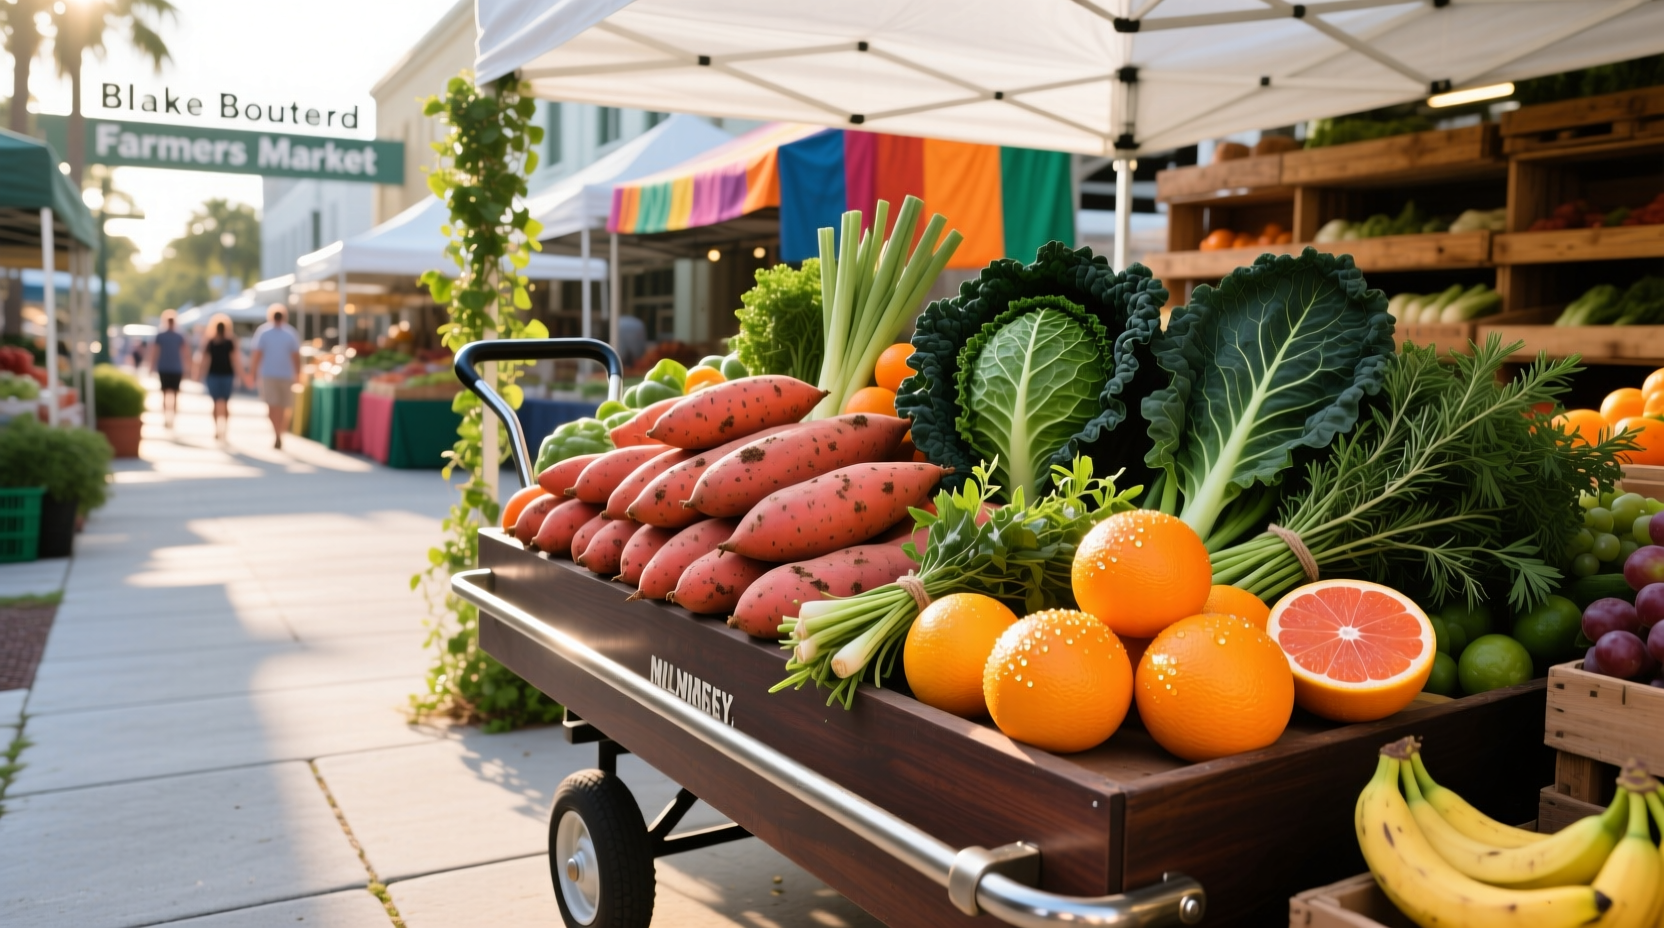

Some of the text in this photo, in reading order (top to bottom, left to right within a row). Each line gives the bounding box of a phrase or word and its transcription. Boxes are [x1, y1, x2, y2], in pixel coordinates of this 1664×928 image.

[102, 83, 359, 129] Blake Bouterd
[96, 123, 378, 176] Farmers Market
